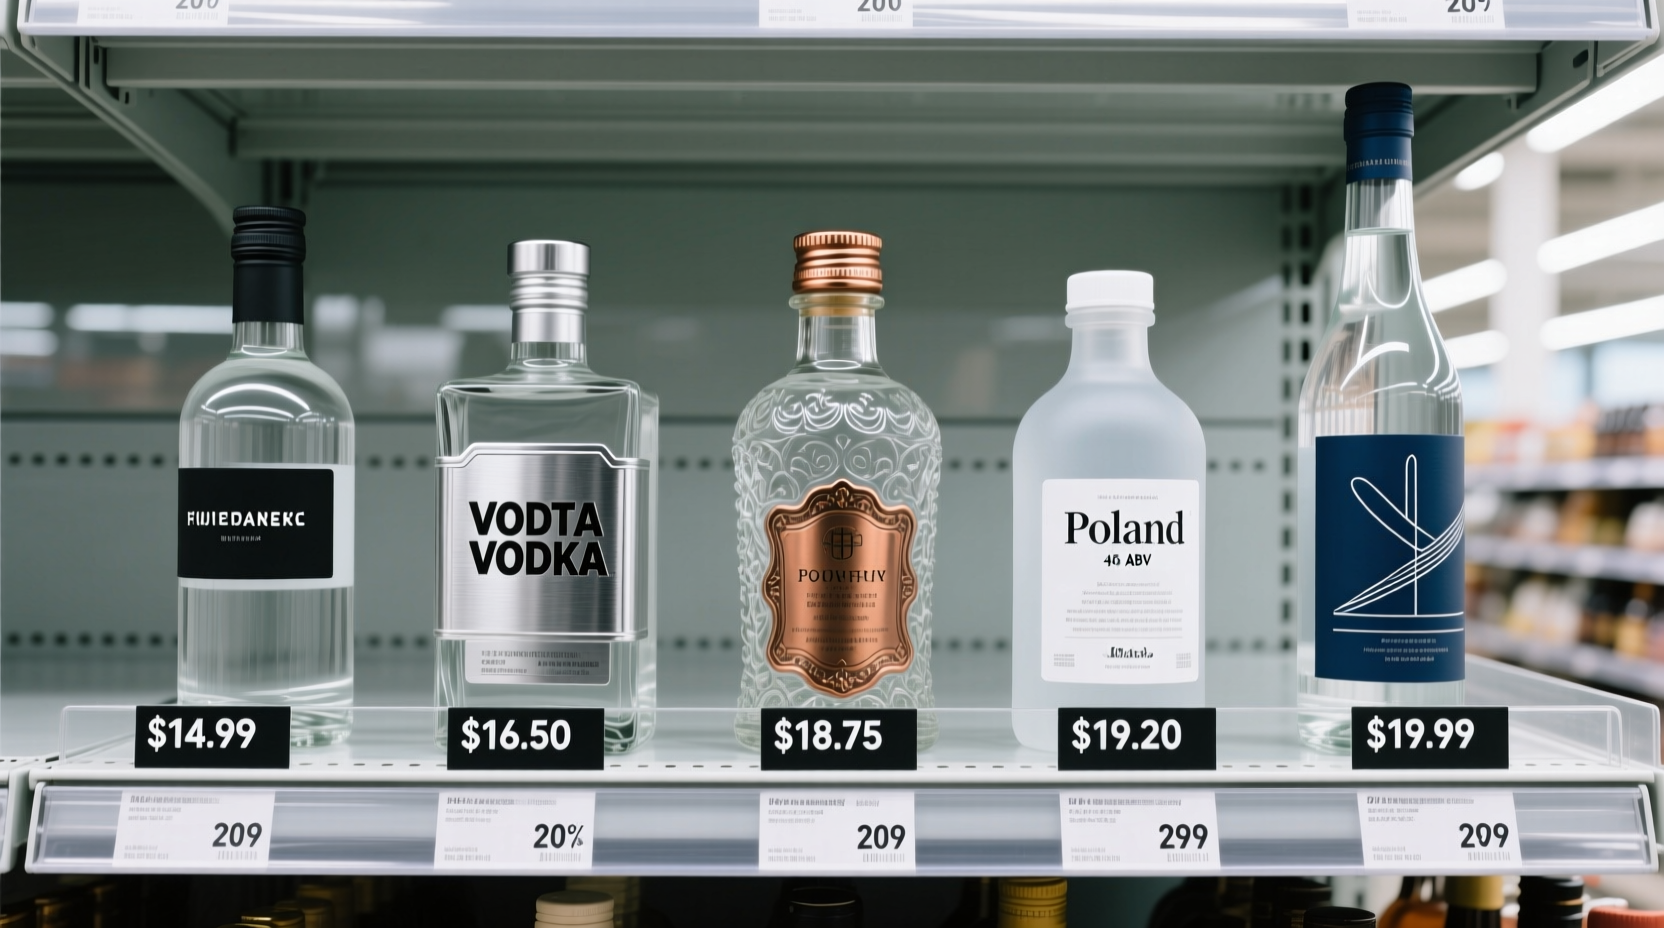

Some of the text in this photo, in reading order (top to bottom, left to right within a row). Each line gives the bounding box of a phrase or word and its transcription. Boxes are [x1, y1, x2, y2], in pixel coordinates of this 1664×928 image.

[469, 501, 604, 536] VODTA
[1064, 509, 1185, 545] Poland
[469, 540, 609, 576] VODKA
[1125, 553, 1152, 567] ABV
[147, 714, 256, 752] $14.99
[461, 716, 571, 754] $16.50
[774, 716, 883, 754] $18.75
[1071, 716, 1182, 754] $19.20
[1366, 715, 1475, 753] $19.99
[212, 822, 263, 848] 209
[533, 823, 584, 849] 20%
[857, 824, 906, 850] 209
[1158, 824, 1208, 849] 299
[1459, 823, 1509, 848] 209
